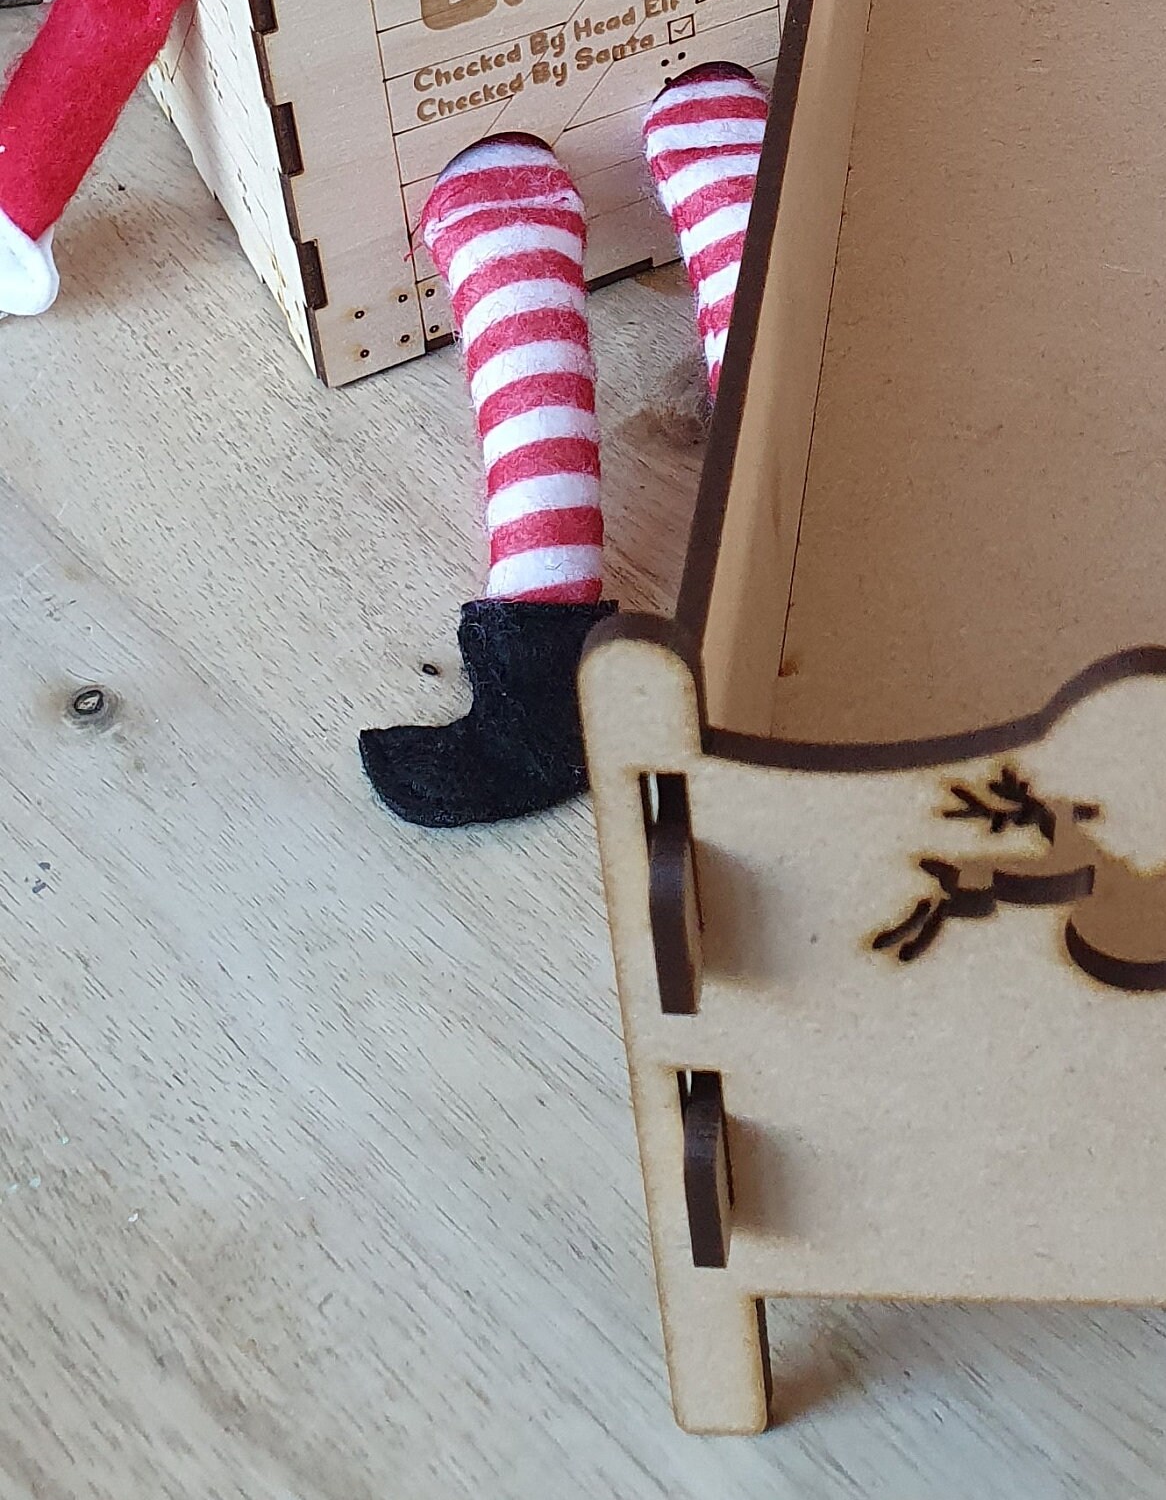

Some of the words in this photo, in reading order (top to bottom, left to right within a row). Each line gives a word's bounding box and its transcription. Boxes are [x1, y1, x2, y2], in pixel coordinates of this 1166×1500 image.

[413, 42, 522, 93] Checked
[530, 31, 566, 58] By
[573, 6, 637, 43] Head
[416, 71, 525, 123] Checked
[532, 60, 568, 87] By
[574, 32, 655, 71] Santa
